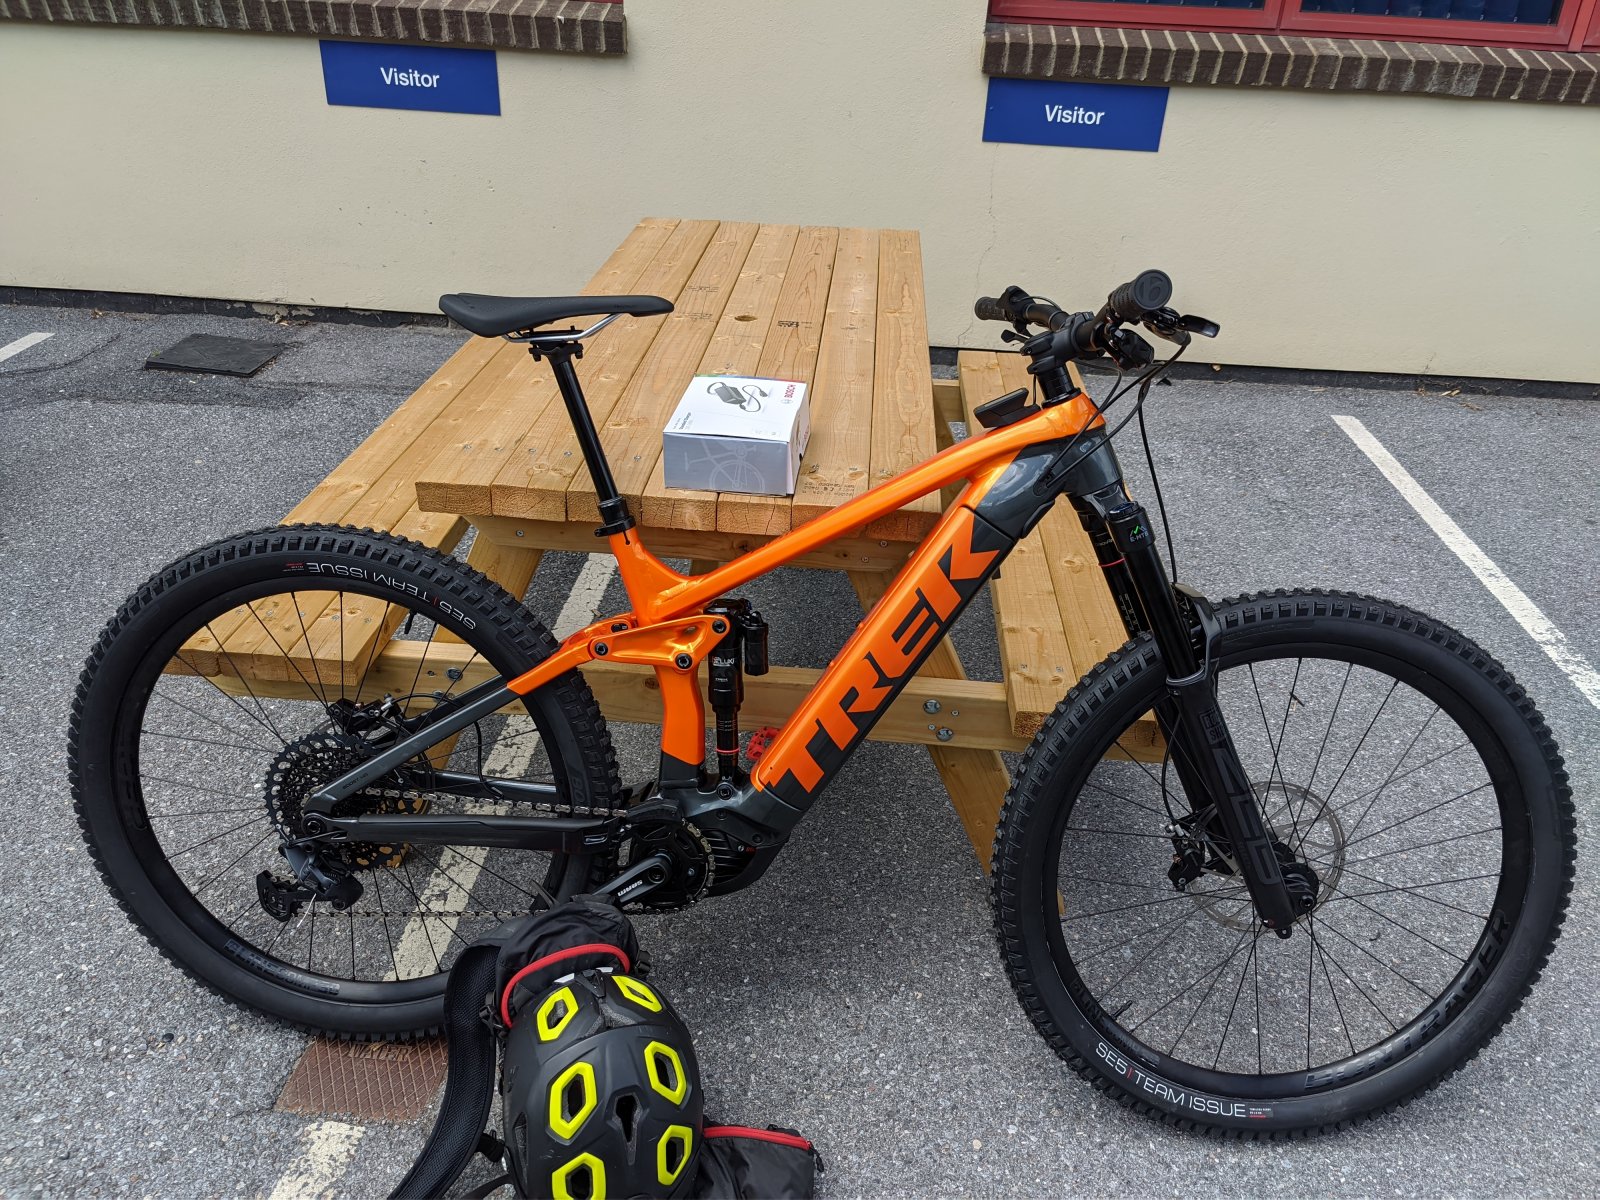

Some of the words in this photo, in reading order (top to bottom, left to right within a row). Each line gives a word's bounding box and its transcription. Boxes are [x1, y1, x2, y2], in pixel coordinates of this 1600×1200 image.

[380, 67, 440, 88] Visitor
[1045, 104, 1105, 125] Visitor
[784, 384, 796, 399] BOSCH
[306, 562, 368, 579] ISSUE
[373, 572, 429, 601] TEAM
[439, 601, 476, 630] SE5
[768, 508, 1000, 794] TREK
[1095, 1042, 1128, 1075] SE5
[1135, 1070, 1185, 1106] TEAM
[1189, 1095, 1247, 1118] ISSUE
